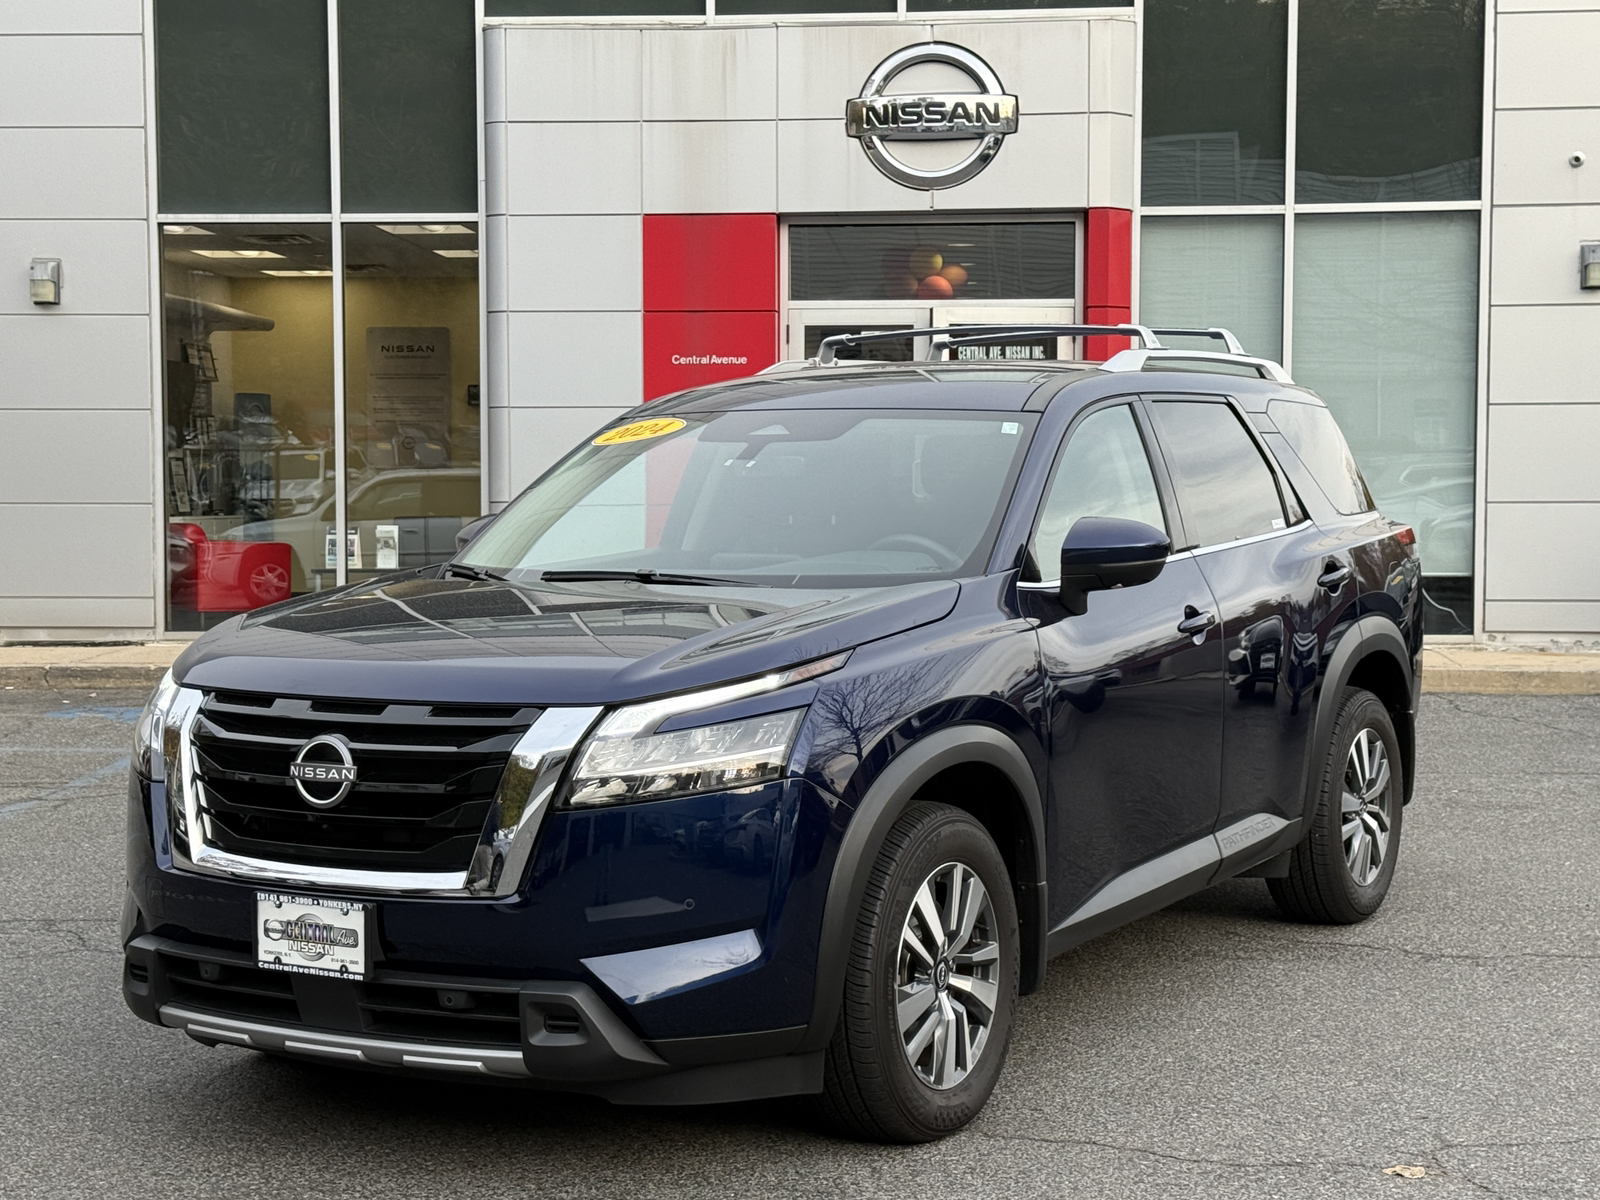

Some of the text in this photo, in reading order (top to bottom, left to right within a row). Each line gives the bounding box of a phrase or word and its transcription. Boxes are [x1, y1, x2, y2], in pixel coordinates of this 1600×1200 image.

[863, 101, 1001, 128] NISSAN
[380, 345, 435, 353] NISSAN
[958, 346, 987, 360] CENTRAL
[988, 346, 1003, 360] AVE.
[1005, 346, 1031, 360] NISSAN
[671, 354, 748, 365] Central Avenue
[601, 421, 676, 443] 2024
[290, 765, 355, 780] NISSAN
[1221, 816, 1276, 850] PATHFINDER
[286, 921, 357, 945] CENTRAL Ave.
[288, 940, 334, 956] NISSAN
[258, 961, 364, 981] CentralAveNissan.com
